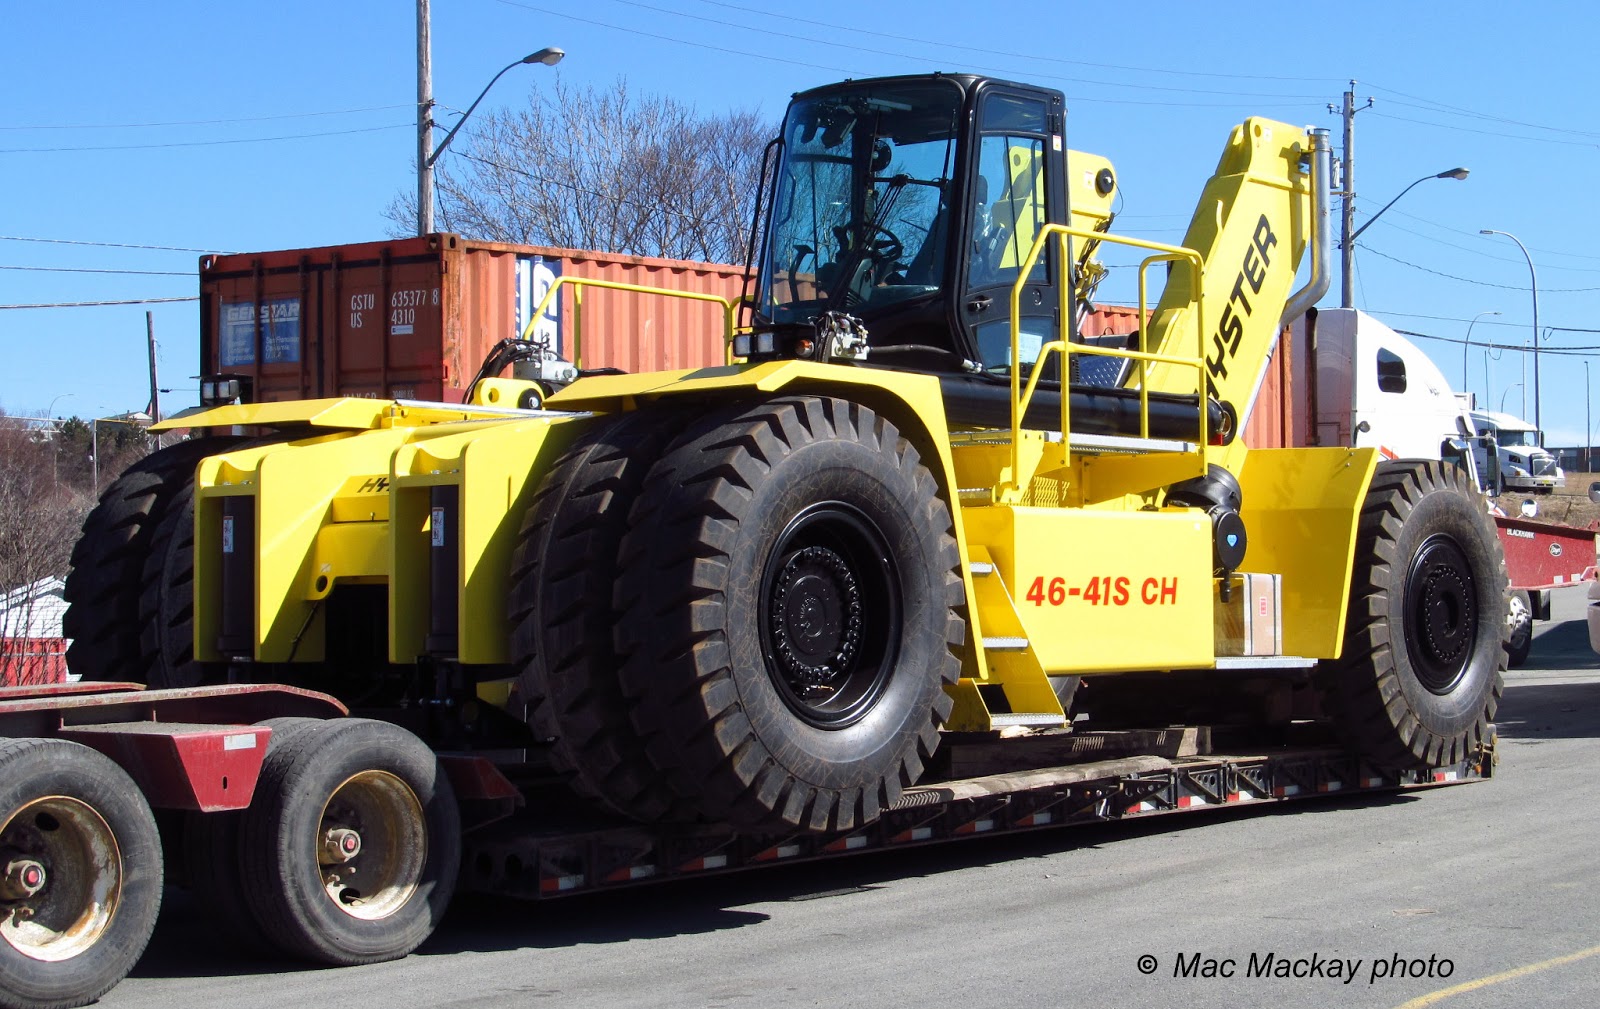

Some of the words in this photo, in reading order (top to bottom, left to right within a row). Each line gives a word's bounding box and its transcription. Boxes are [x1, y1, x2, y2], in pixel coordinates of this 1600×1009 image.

[351, 294, 375, 311] GSTU
[391, 290, 427, 307] 635377
[432, 288, 440, 305] 8
[350, 312, 363, 328] US
[391, 308, 415, 325] 4310
[1026, 576, 1130, 606] 46-41S
[1141, 576, 1178, 605] CH
